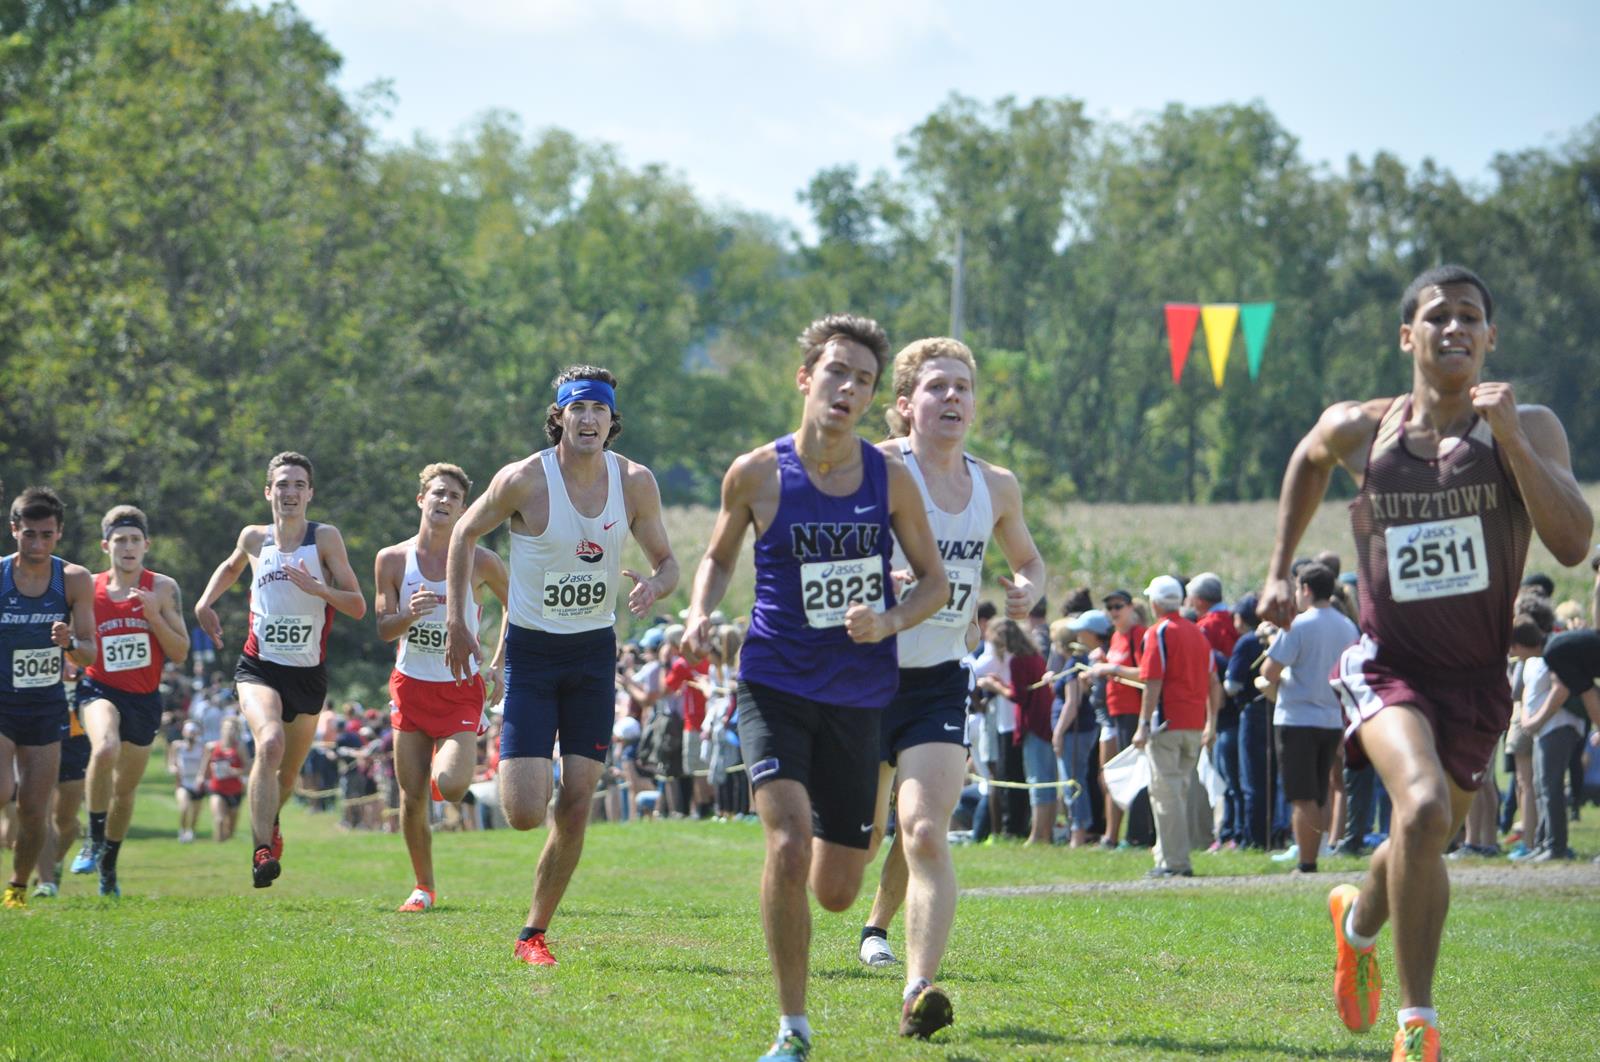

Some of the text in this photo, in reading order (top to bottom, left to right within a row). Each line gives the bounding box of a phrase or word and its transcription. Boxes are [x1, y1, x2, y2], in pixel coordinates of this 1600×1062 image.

[1371, 483, 1498, 519] KUTZTOWN
[790, 523, 881, 558] NYU
[936, 540, 985, 560] HACA
[1397, 536, 1476, 580] 2511
[544, 581, 606, 607] 3089
[804, 573, 882, 610] 2823
[265, 625, 312, 643] 2567
[106, 642, 147, 662] 3175
[14, 657, 60, 677] 3048
